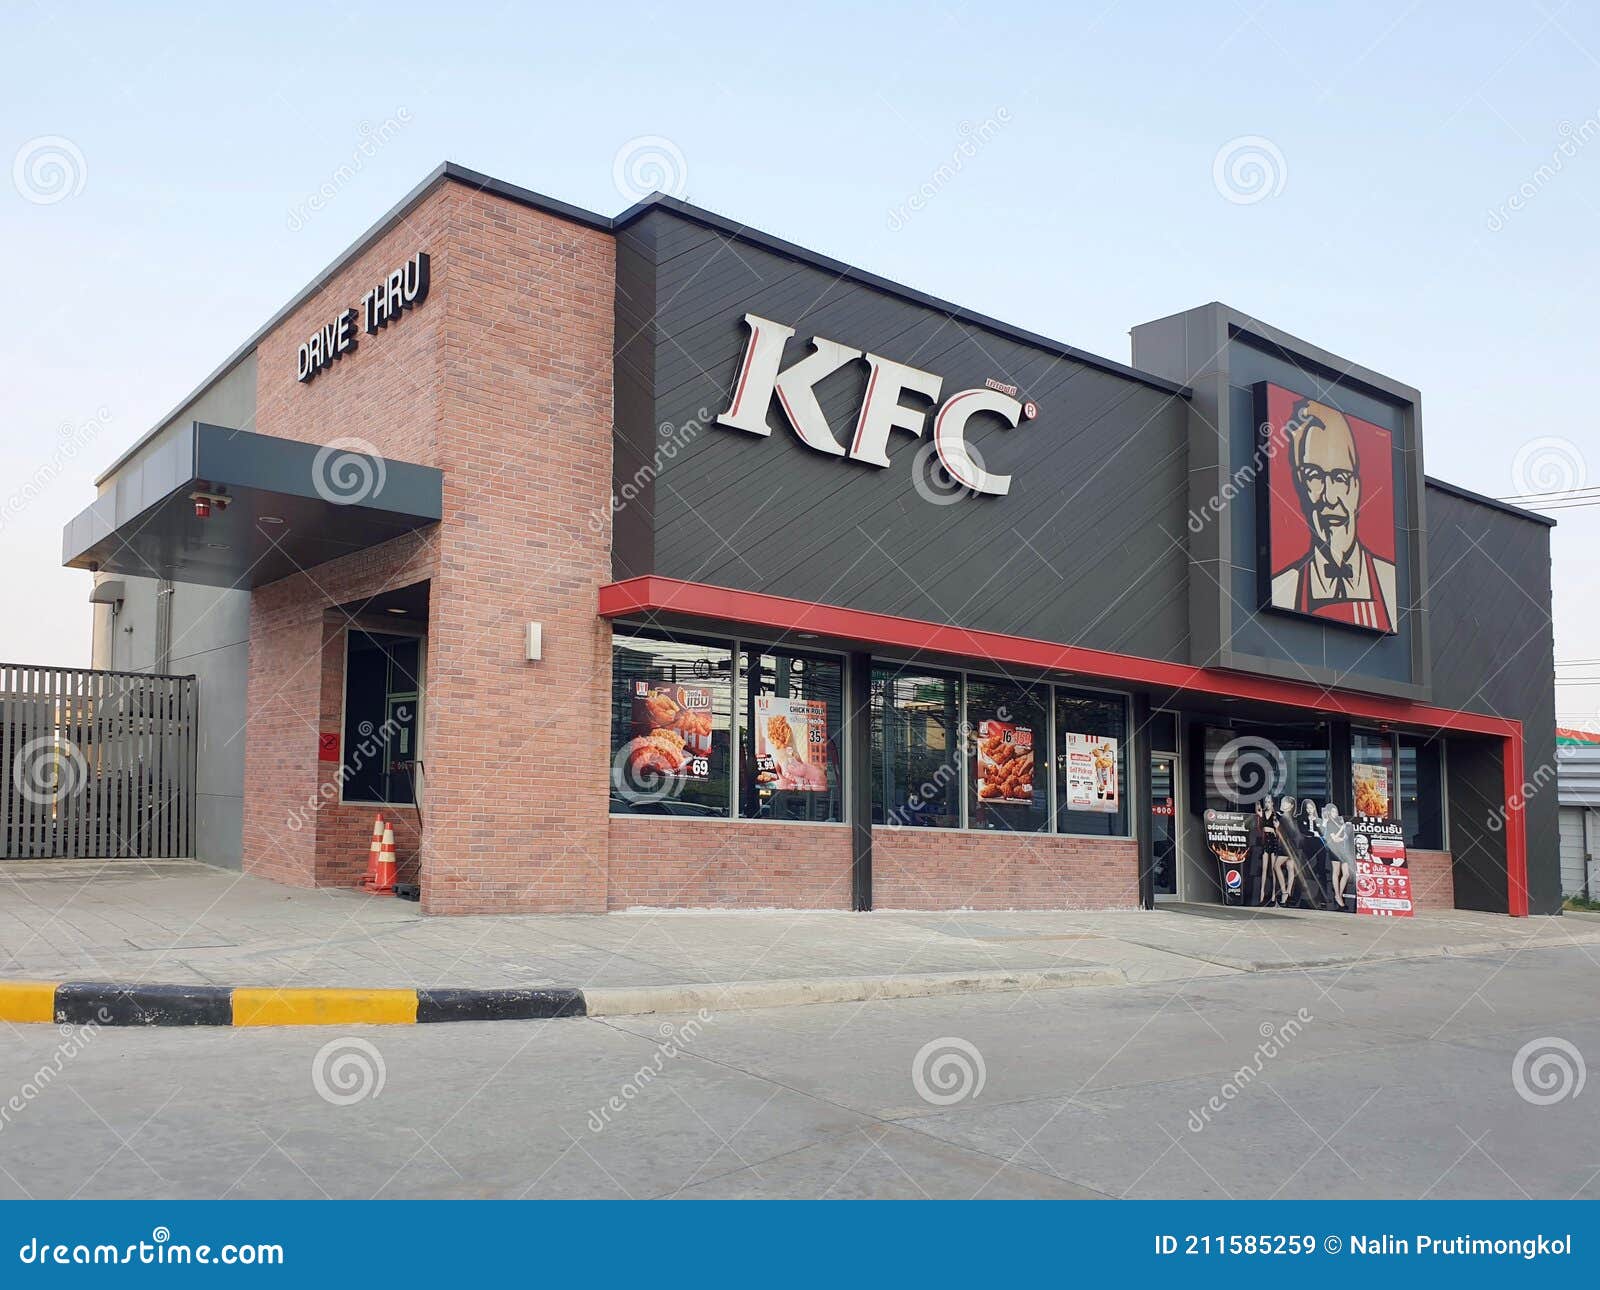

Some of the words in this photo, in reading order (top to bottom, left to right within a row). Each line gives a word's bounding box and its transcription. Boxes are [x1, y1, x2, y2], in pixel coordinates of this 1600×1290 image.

[298, 308, 356, 384] DRIVE
[361, 251, 428, 334] THRU
[716, 313, 1023, 495] KFC
[809, 730, 821, 742] 35
[1002, 730, 1012, 742] 16
[692, 760, 708, 775] 69
[1353, 822, 1402, 834] นดีต้อนรับ
[1356, 861, 1371, 874] FC
